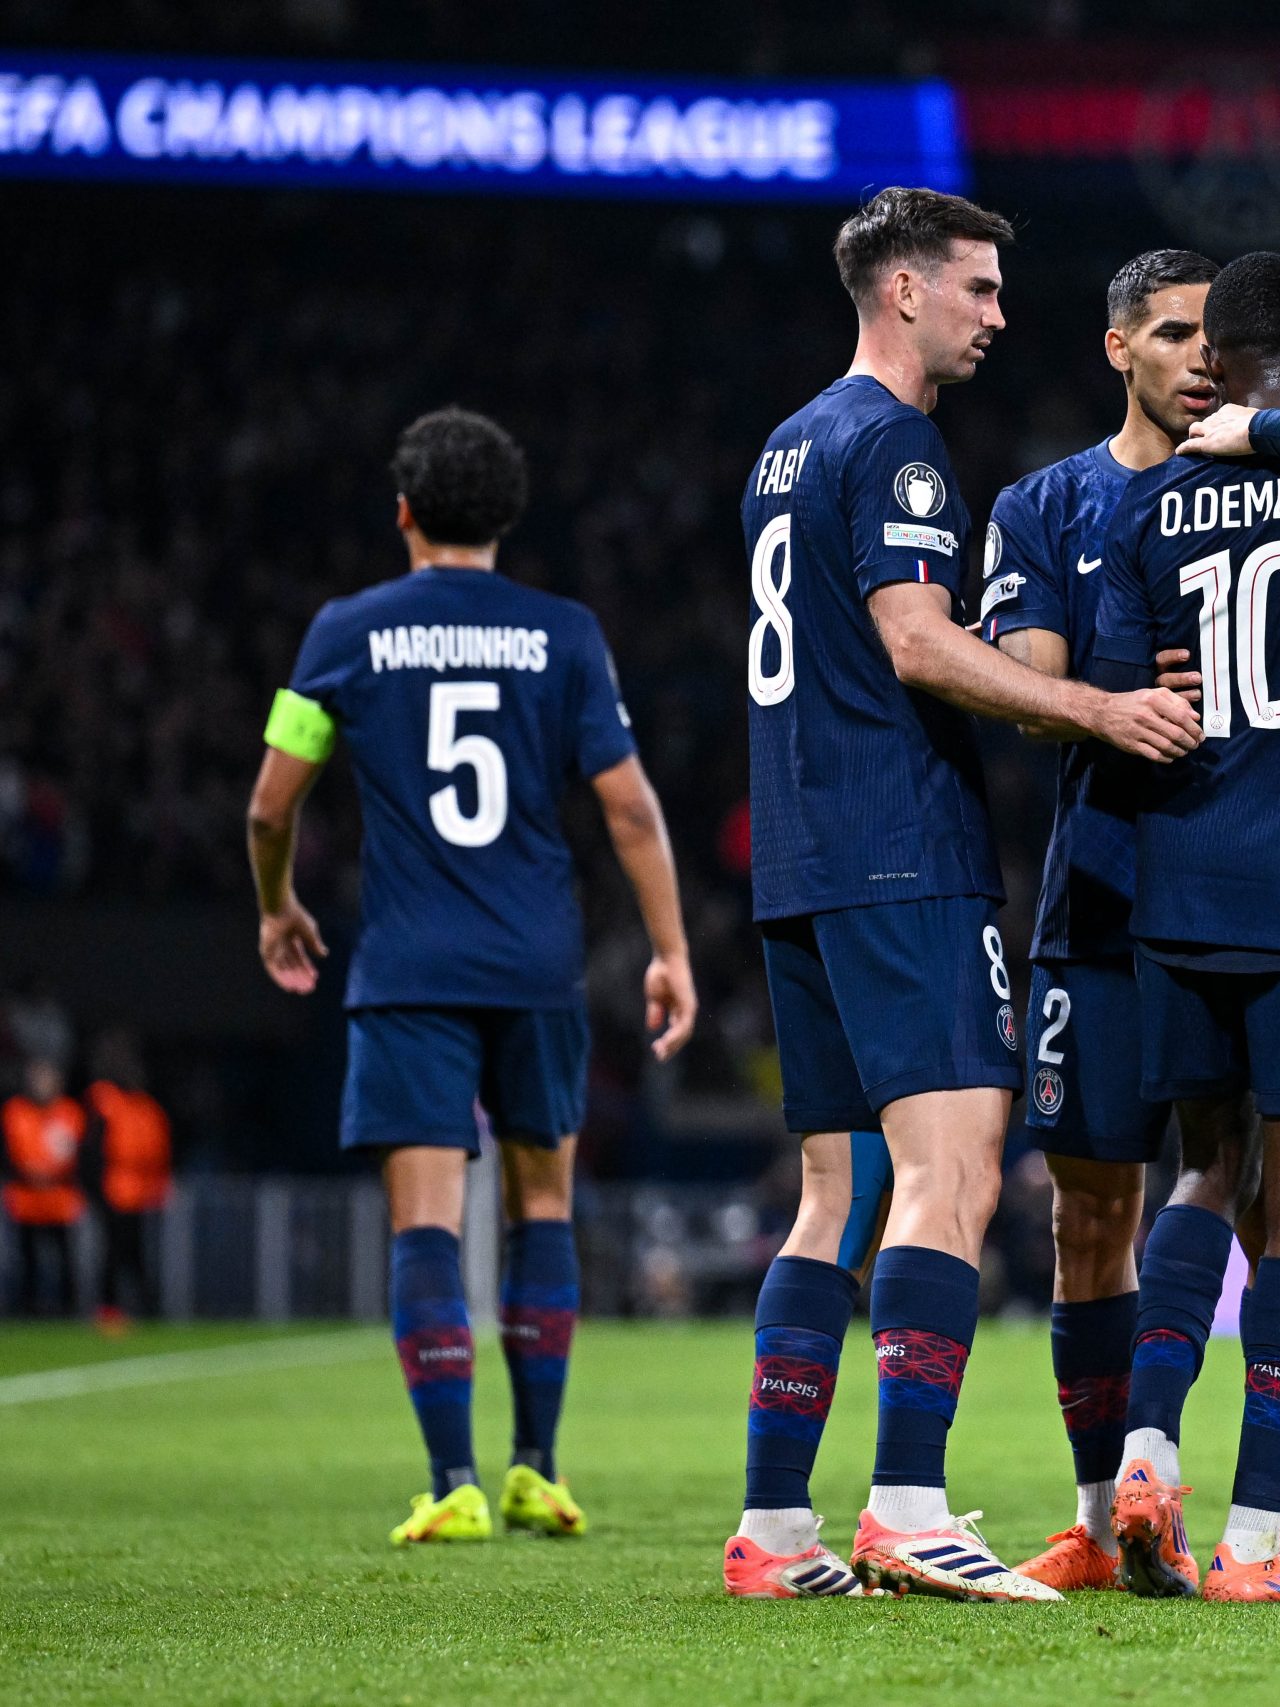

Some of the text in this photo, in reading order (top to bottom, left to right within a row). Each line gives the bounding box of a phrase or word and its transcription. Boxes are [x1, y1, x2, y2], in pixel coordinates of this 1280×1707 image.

[116, 76, 547, 172] CHAMPIONS
[551, 92, 838, 180] LEAGUE
[748, 513, 795, 706] 8
[368, 625, 548, 674] MARQUINHOS
[427, 681, 508, 848] 5
[982, 925, 1011, 1000] 8
[1037, 987, 1071, 1065] 2
[761, 1377, 819, 1398] PARIS
